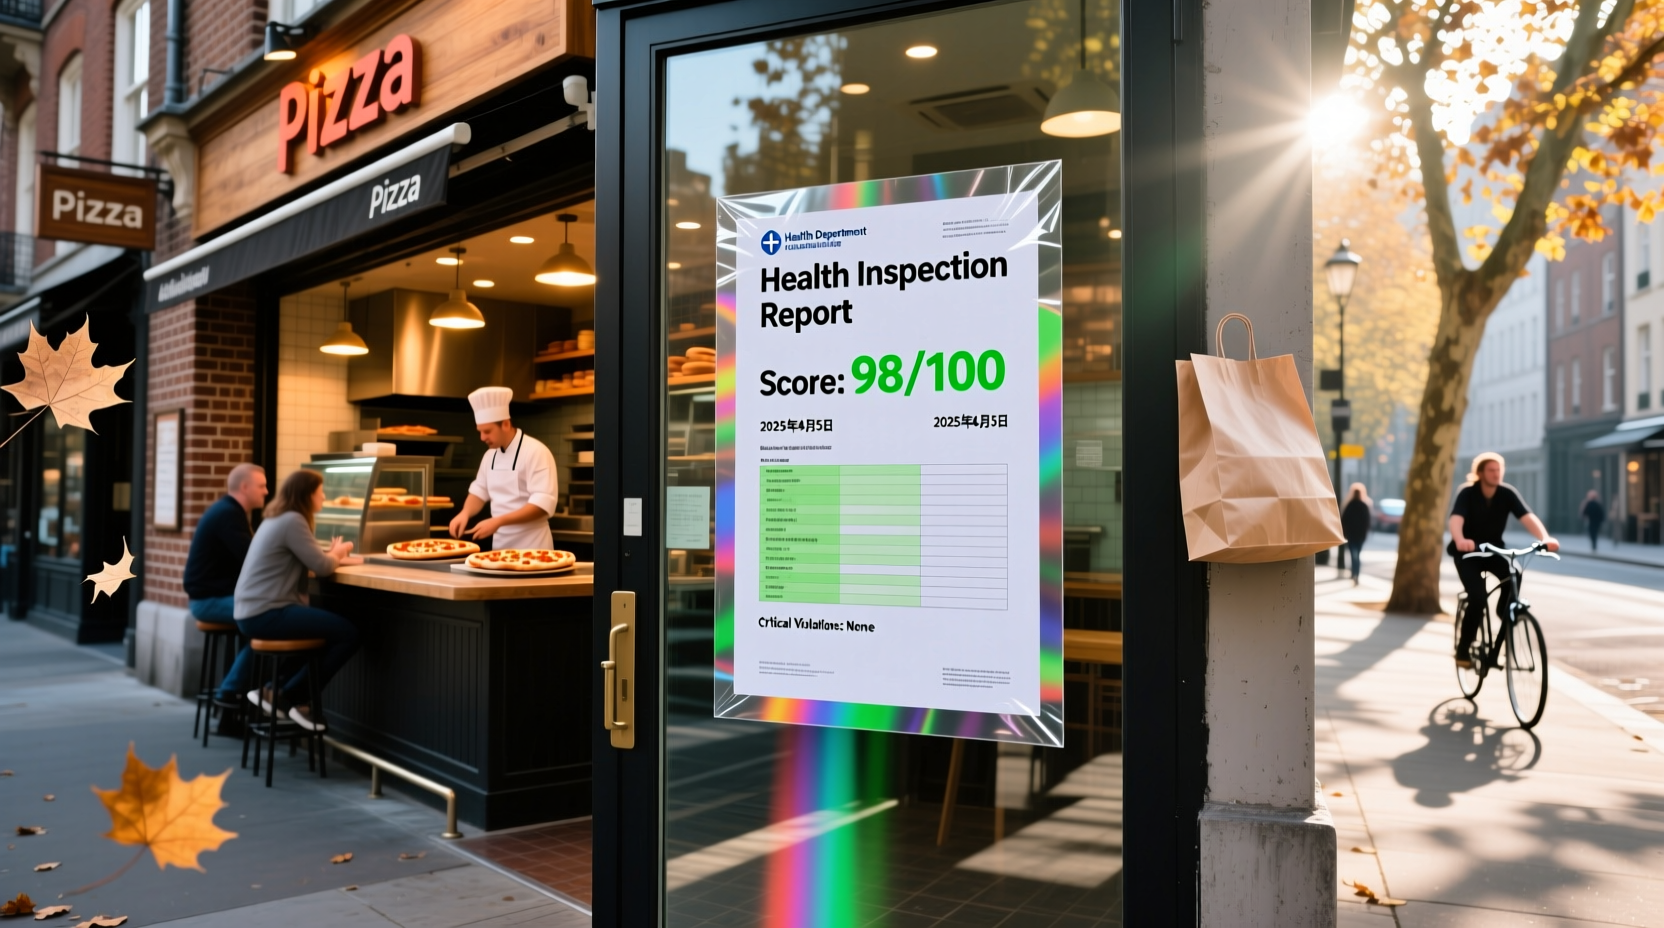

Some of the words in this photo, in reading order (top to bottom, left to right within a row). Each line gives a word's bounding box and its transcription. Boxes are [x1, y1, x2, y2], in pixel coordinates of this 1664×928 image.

[277, 33, 423, 174] Pizza
[52, 189, 144, 230] Pizza
[368, 174, 422, 219] Pizza
[761, 261, 849, 293] Health
[858, 251, 1008, 291] Inspection
[761, 300, 853, 333] Report
[760, 370, 845, 396] Score:
[851, 349, 1006, 396] 98/100
[846, 620, 876, 632] None
